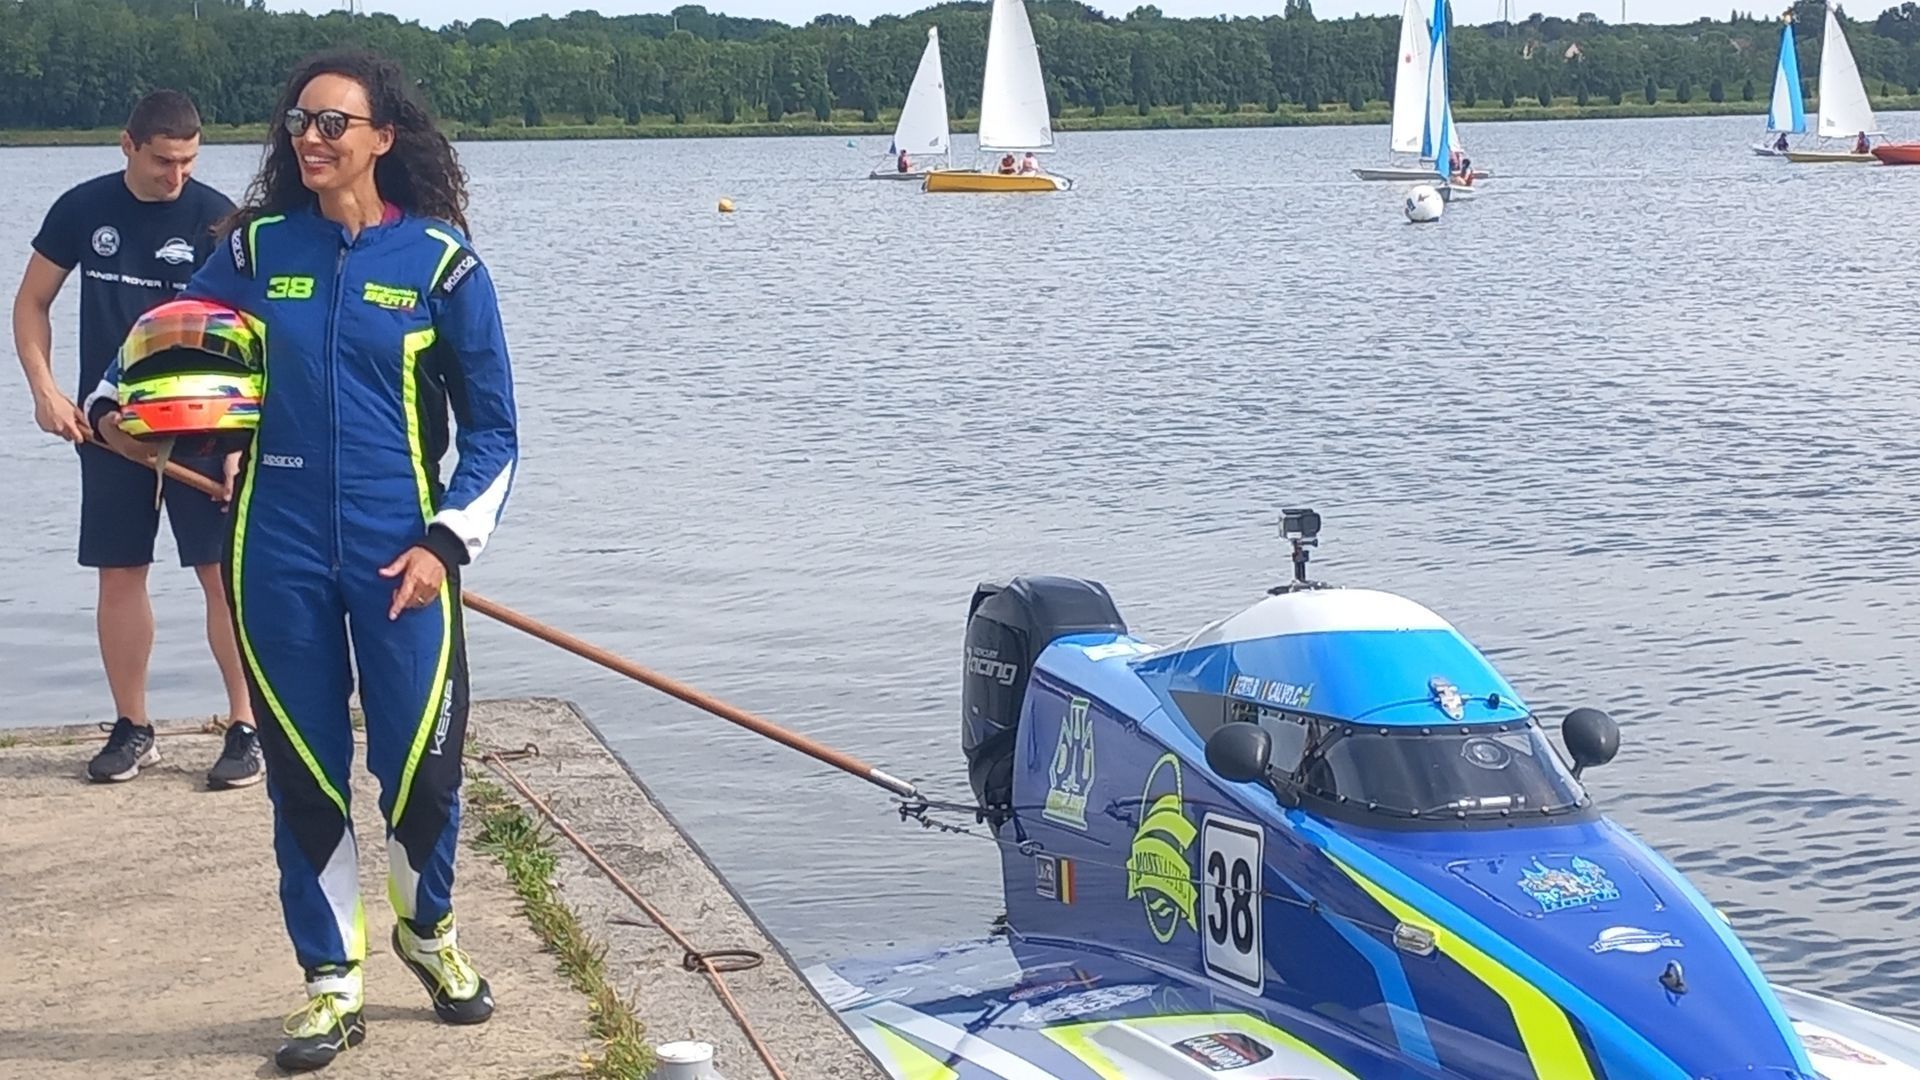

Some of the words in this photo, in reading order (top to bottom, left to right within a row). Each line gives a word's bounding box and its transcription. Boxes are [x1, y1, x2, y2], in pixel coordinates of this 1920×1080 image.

[121, 275, 163, 289] ROVER
[267, 276, 315, 299] 38
[443, 255, 479, 293] sparco
[429, 679, 453, 756] KERB
[1208, 850, 1254, 955] 38
